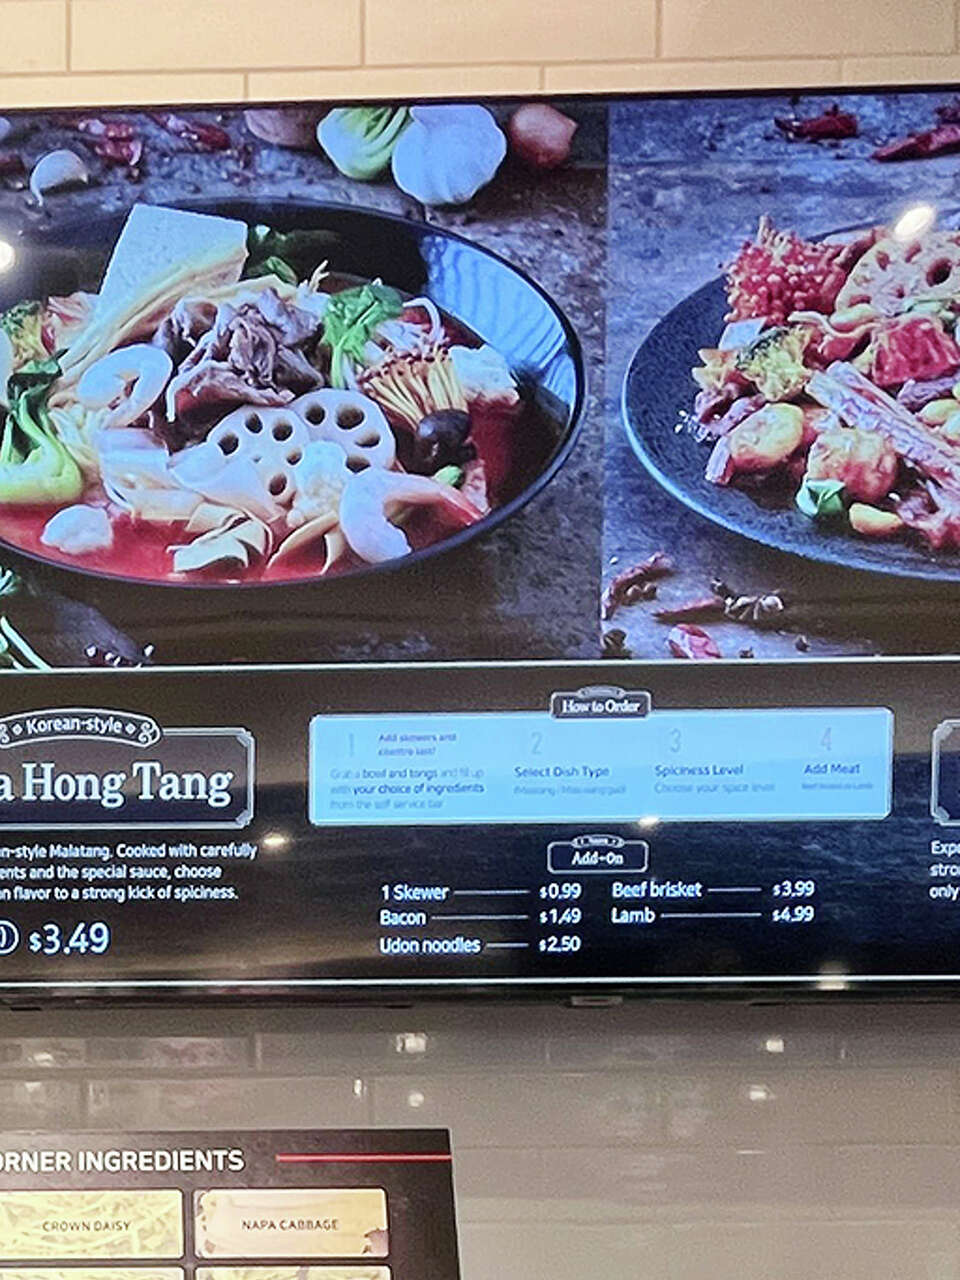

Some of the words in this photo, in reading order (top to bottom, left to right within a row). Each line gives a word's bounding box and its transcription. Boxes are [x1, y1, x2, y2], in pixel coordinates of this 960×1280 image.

[562, 699, 589, 713] How
[592, 700, 604, 713] to
[605, 699, 641, 713] Order
[26, 715, 123, 735] Korean-style
[531, 731, 543, 755] 2
[668, 727, 682, 753] 3
[820, 727, 832, 751] 4
[388, 768, 408, 779] and
[409, 768, 438, 781] tongs
[514, 766, 551, 777] Select
[553, 766, 580, 777] Dish
[581, 765, 610, 778] Type
[654, 764, 711, 777] Spiciness
[712, 763, 744, 776] Level
[803, 763, 828, 774] Add
[830, 763, 860, 774] Meat
[21, 761, 127, 808] Hong
[132, 761, 234, 808] Tang
[353, 785, 376, 796] your
[377, 783, 411, 795] choice
[413, 783, 425, 795] of
[426, 782, 485, 797] ingredients
[49, 843, 113, 861] Malatang.
[116, 843, 166, 858] Cooked
[168, 843, 198, 858] with
[200, 842, 258, 860] carefully
[930, 840, 960, 858] Exp
[570, 850, 624, 867] Add-On
[29, 864, 55, 880] and
[56, 864, 80, 879] the
[81, 864, 127, 882] special
[129, 866, 172, 880] sauce,
[173, 864, 222, 879] choose
[13, 885, 52, 901] flavor
[54, 886, 69, 900] to
[70, 888, 80, 900] a
[81, 886, 126, 904] strong
[127, 885, 156, 900] kick
[156, 885, 173, 900] of
[173, 885, 240, 903] spiciness.
[381, 885, 390, 900] 1
[393, 885, 450, 901] Skewer
[539, 883, 582, 900] $0.99
[611, 881, 648, 899] Beef
[649, 881, 703, 898] brisket
[772, 881, 816, 897] $3.99
[929, 883, 959, 901] only
[380, 910, 427, 927] Bacon
[539, 908, 582, 925] $1.49
[611, 908, 656, 925] Lamb
[772, 906, 815, 924] $4.99
[28, 921, 110, 956] $3.49
[380, 937, 421, 954] Udon
[422, 937, 482, 954] noodles
[539, 935, 582, 953] $2.50
[78, 1148, 246, 1173] INGREDIENTS
[42, 1220, 92, 1233] CROWN
[94, 1219, 132, 1233] DAISY
[241, 1218, 277, 1231] NAPA
[278, 1218, 340, 1231] CABBAGE
